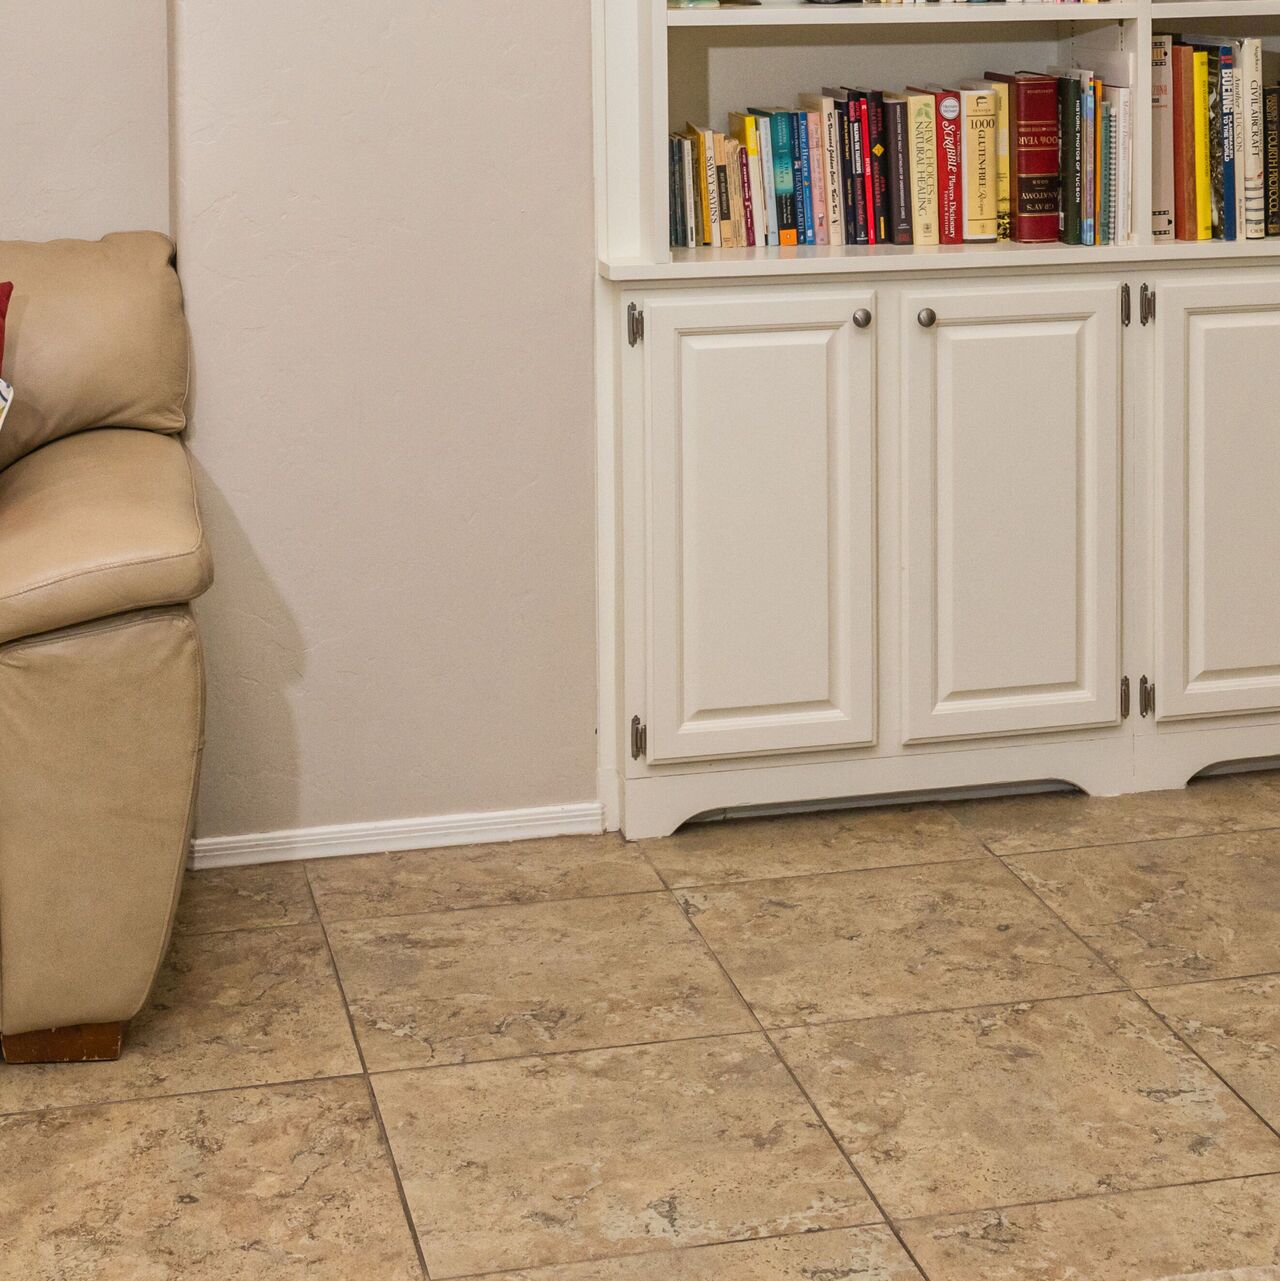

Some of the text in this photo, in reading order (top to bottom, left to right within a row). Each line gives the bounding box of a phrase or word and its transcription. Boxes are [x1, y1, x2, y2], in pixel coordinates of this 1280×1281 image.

[1222, 69, 1234, 113] BOEING
[971, 119, 995, 129] 1000
[1223, 115, 1229, 123] TO
[1234, 76, 1243, 152] Another TUCSON
[1250, 80, 1260, 157] CIVIL AIRCRAFT
[924, 121, 933, 147] NEW
[942, 121, 957, 173] SCRABBLE
[1019, 136, 1058, 145] 00th YEAR
[1267, 130, 1278, 166] FOURTH
[706, 156, 715, 185] SAVVY
[915, 121, 927, 217] NATURAL HEALING
[925, 148, 935, 196] CHOICES
[977, 130, 986, 216] GLUTEN-FREE Recipes
[1075, 162, 1080, 171] OF
[947, 175, 956, 200] Players
[1021, 192, 1058, 200] ANATOMY
[1268, 169, 1279, 215] PROTOCOL
[796, 208, 804, 232] EARTH
[947, 202, 957, 238] Dictionary
